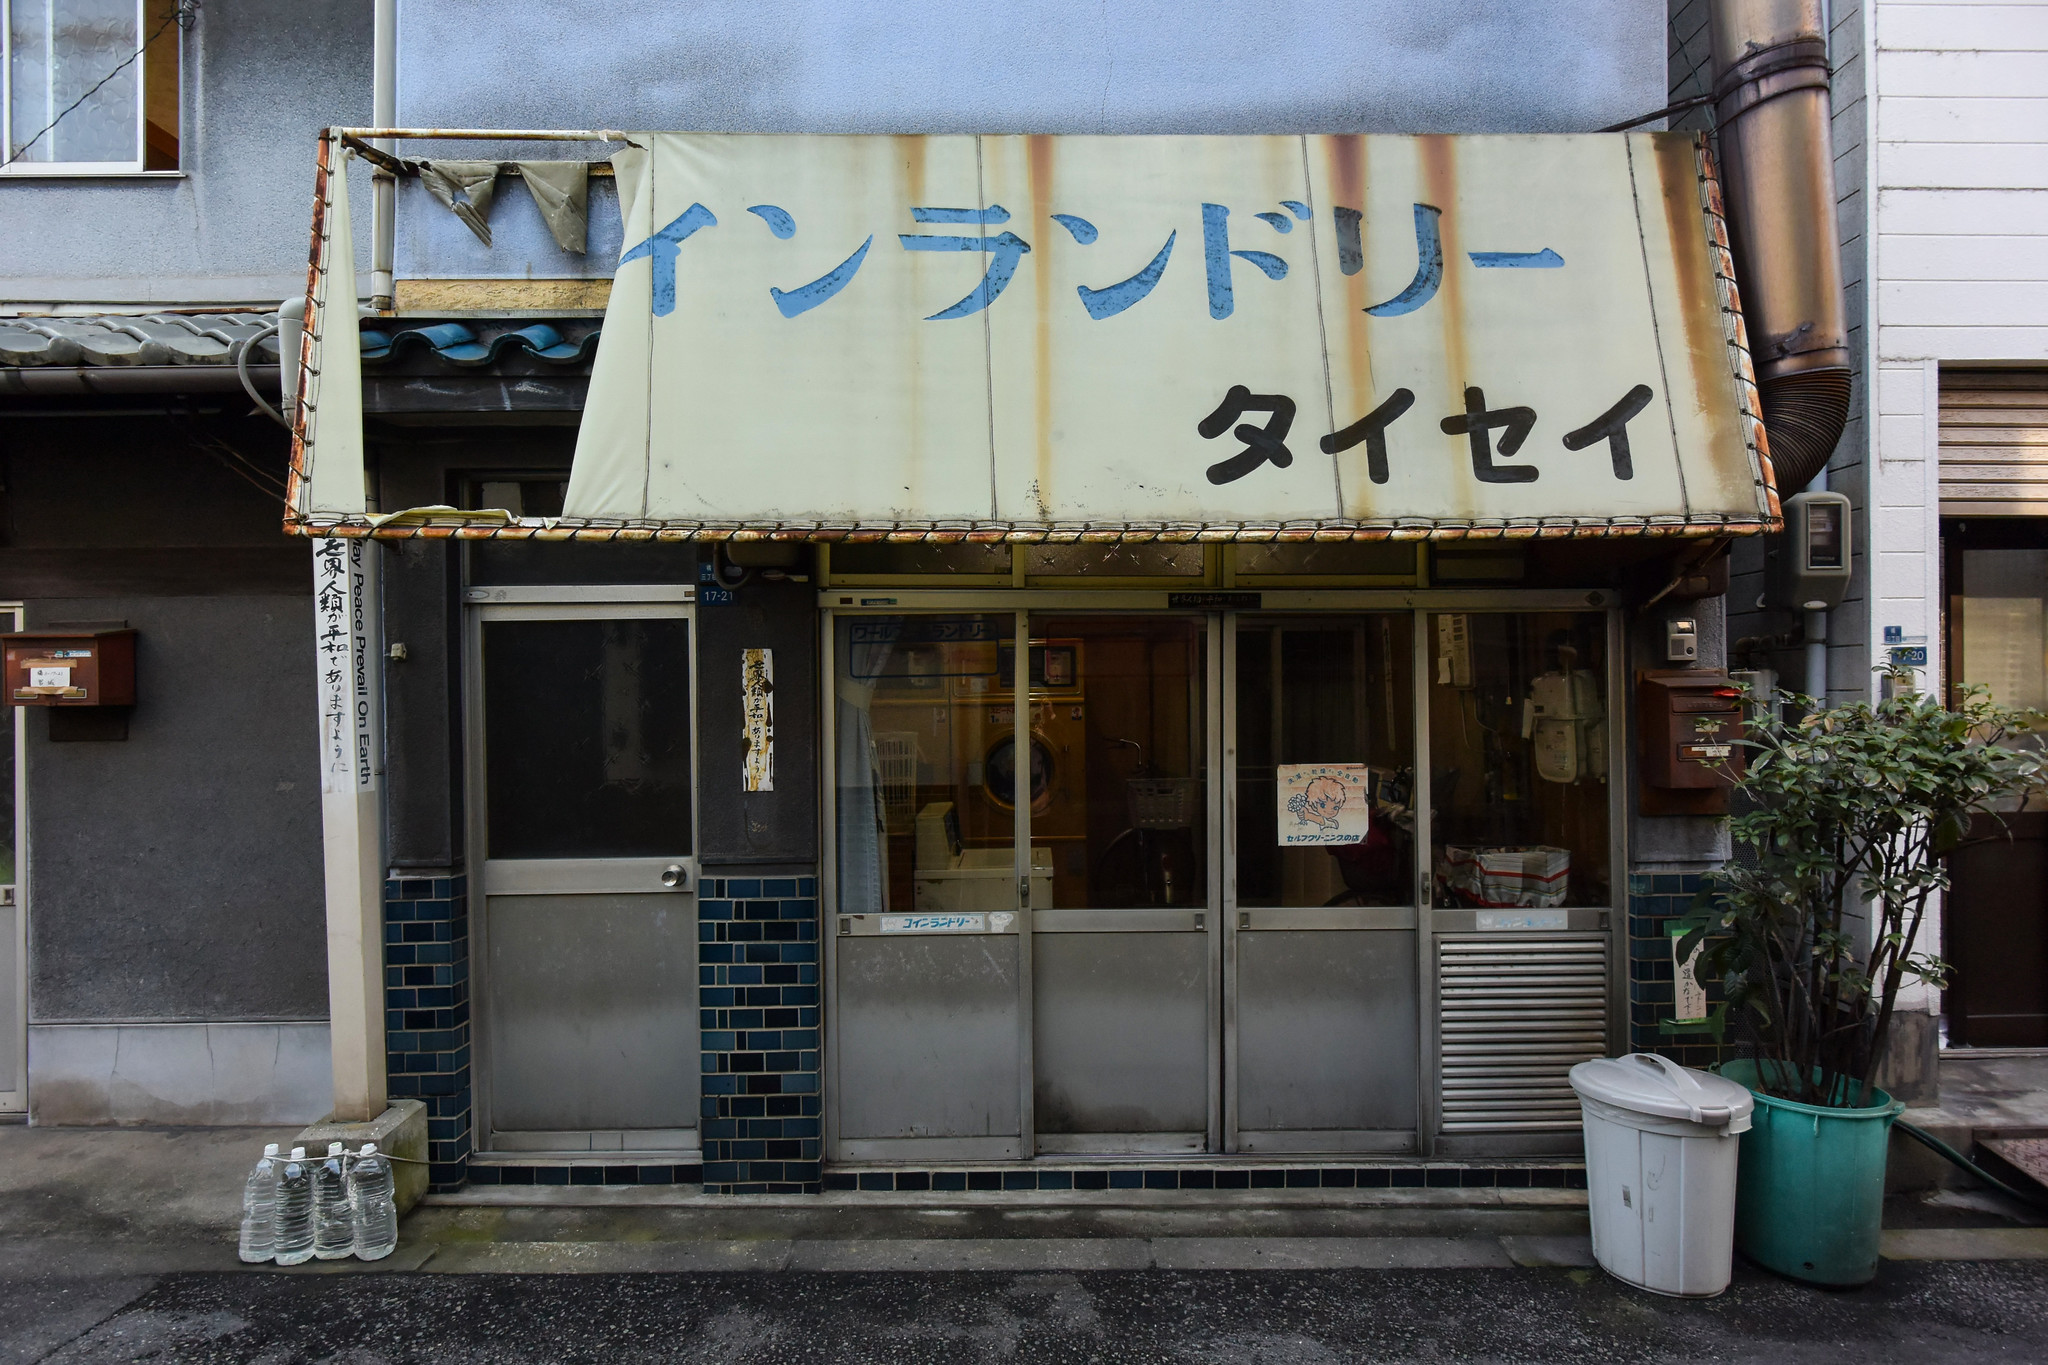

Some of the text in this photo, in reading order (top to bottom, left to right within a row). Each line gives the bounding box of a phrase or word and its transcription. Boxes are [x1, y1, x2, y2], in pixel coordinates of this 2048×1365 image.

[618, 200, 1565, 320] インランドリー
[1197, 384, 1654, 485] タイセイ
[353, 574, 364, 631] Peace
[704, 590, 733, 601] 17-21
[315, 538, 349, 773] 世界人類が平和でありますように
[355, 636, 367, 696] Prevail
[357, 701, 369, 728] On
[359, 734, 370, 785] Earth
[902, 917, 970, 928] コインランドリー
